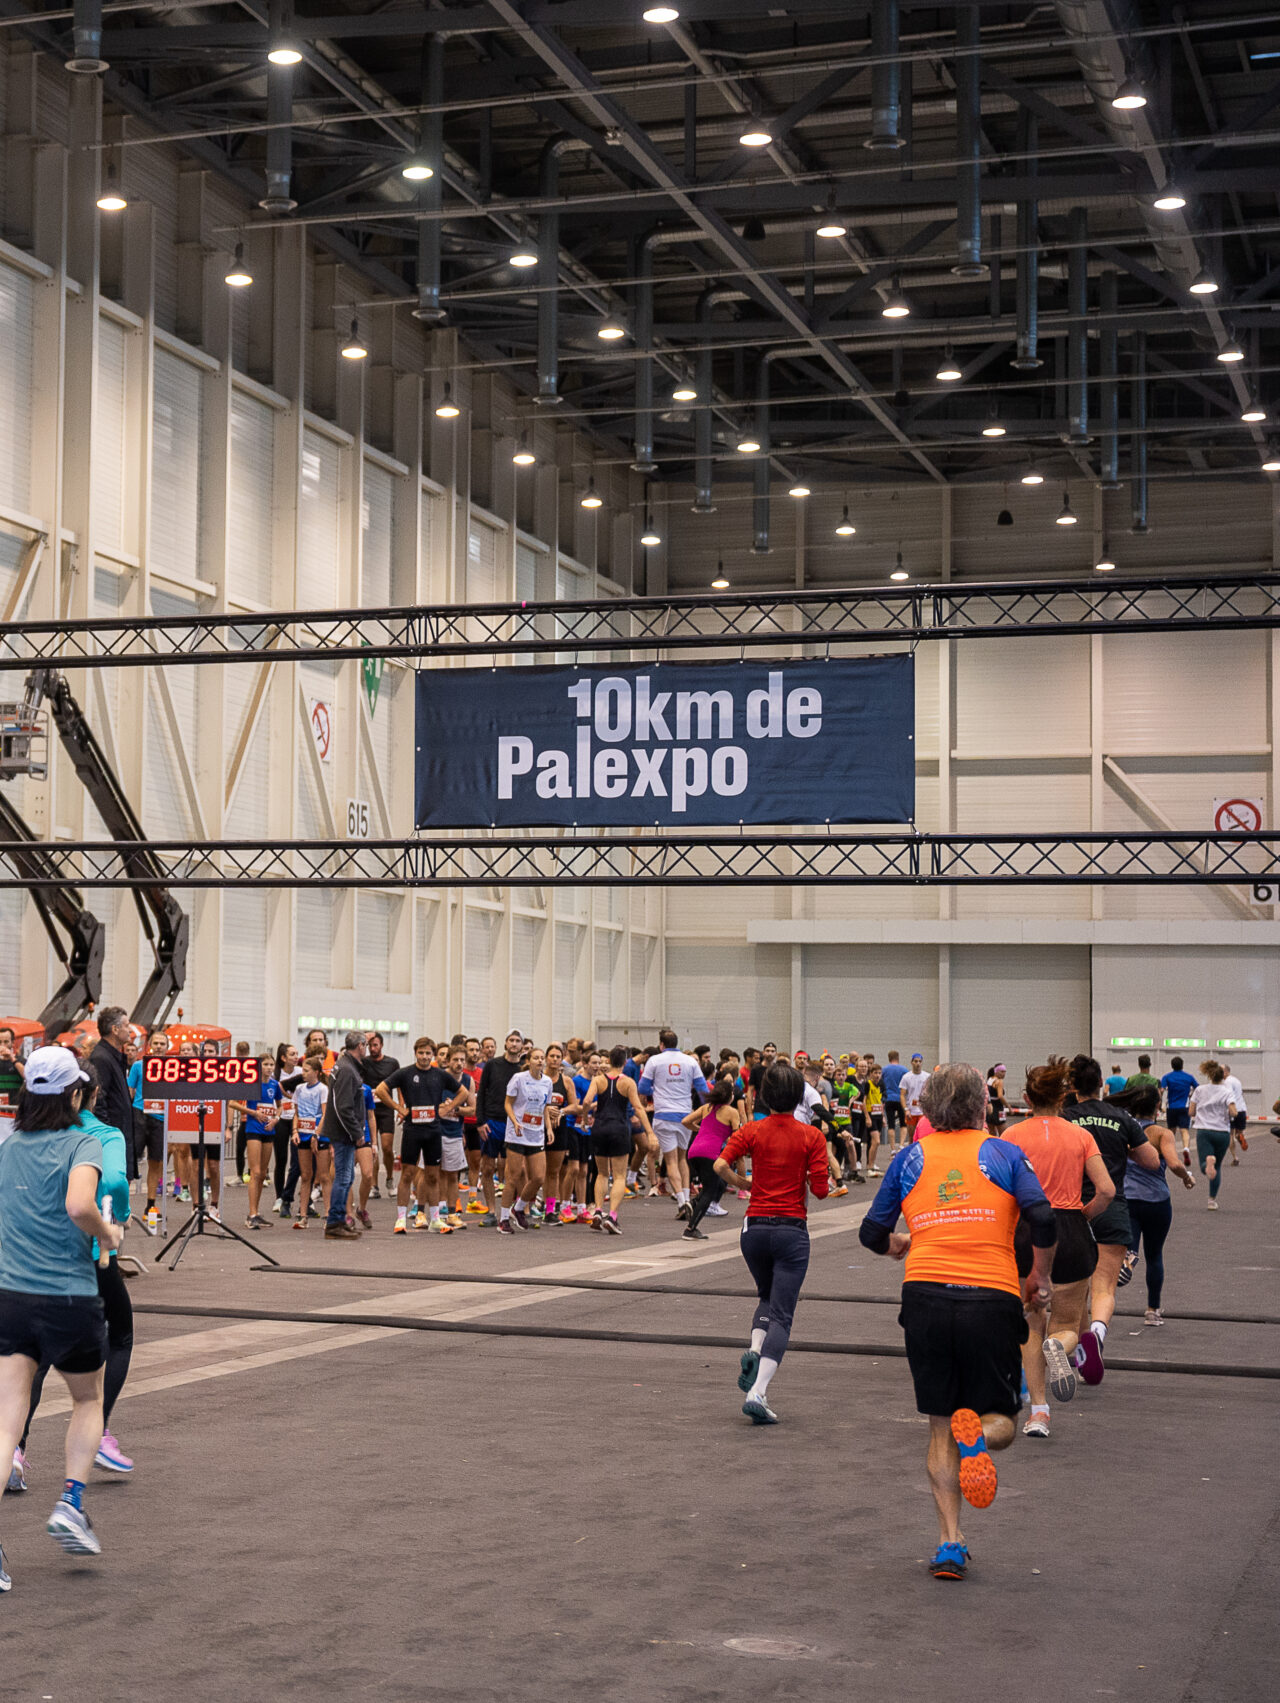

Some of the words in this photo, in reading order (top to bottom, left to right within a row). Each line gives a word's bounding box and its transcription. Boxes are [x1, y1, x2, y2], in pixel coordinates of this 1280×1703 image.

[567, 674, 734, 743] 10km
[746, 671, 823, 739] de
[497, 725, 749, 812] Palexpo
[348, 801, 368, 837] 615
[146, 1057, 258, 1084] 08:35:05
[175, 1104, 214, 1115] ROUS
